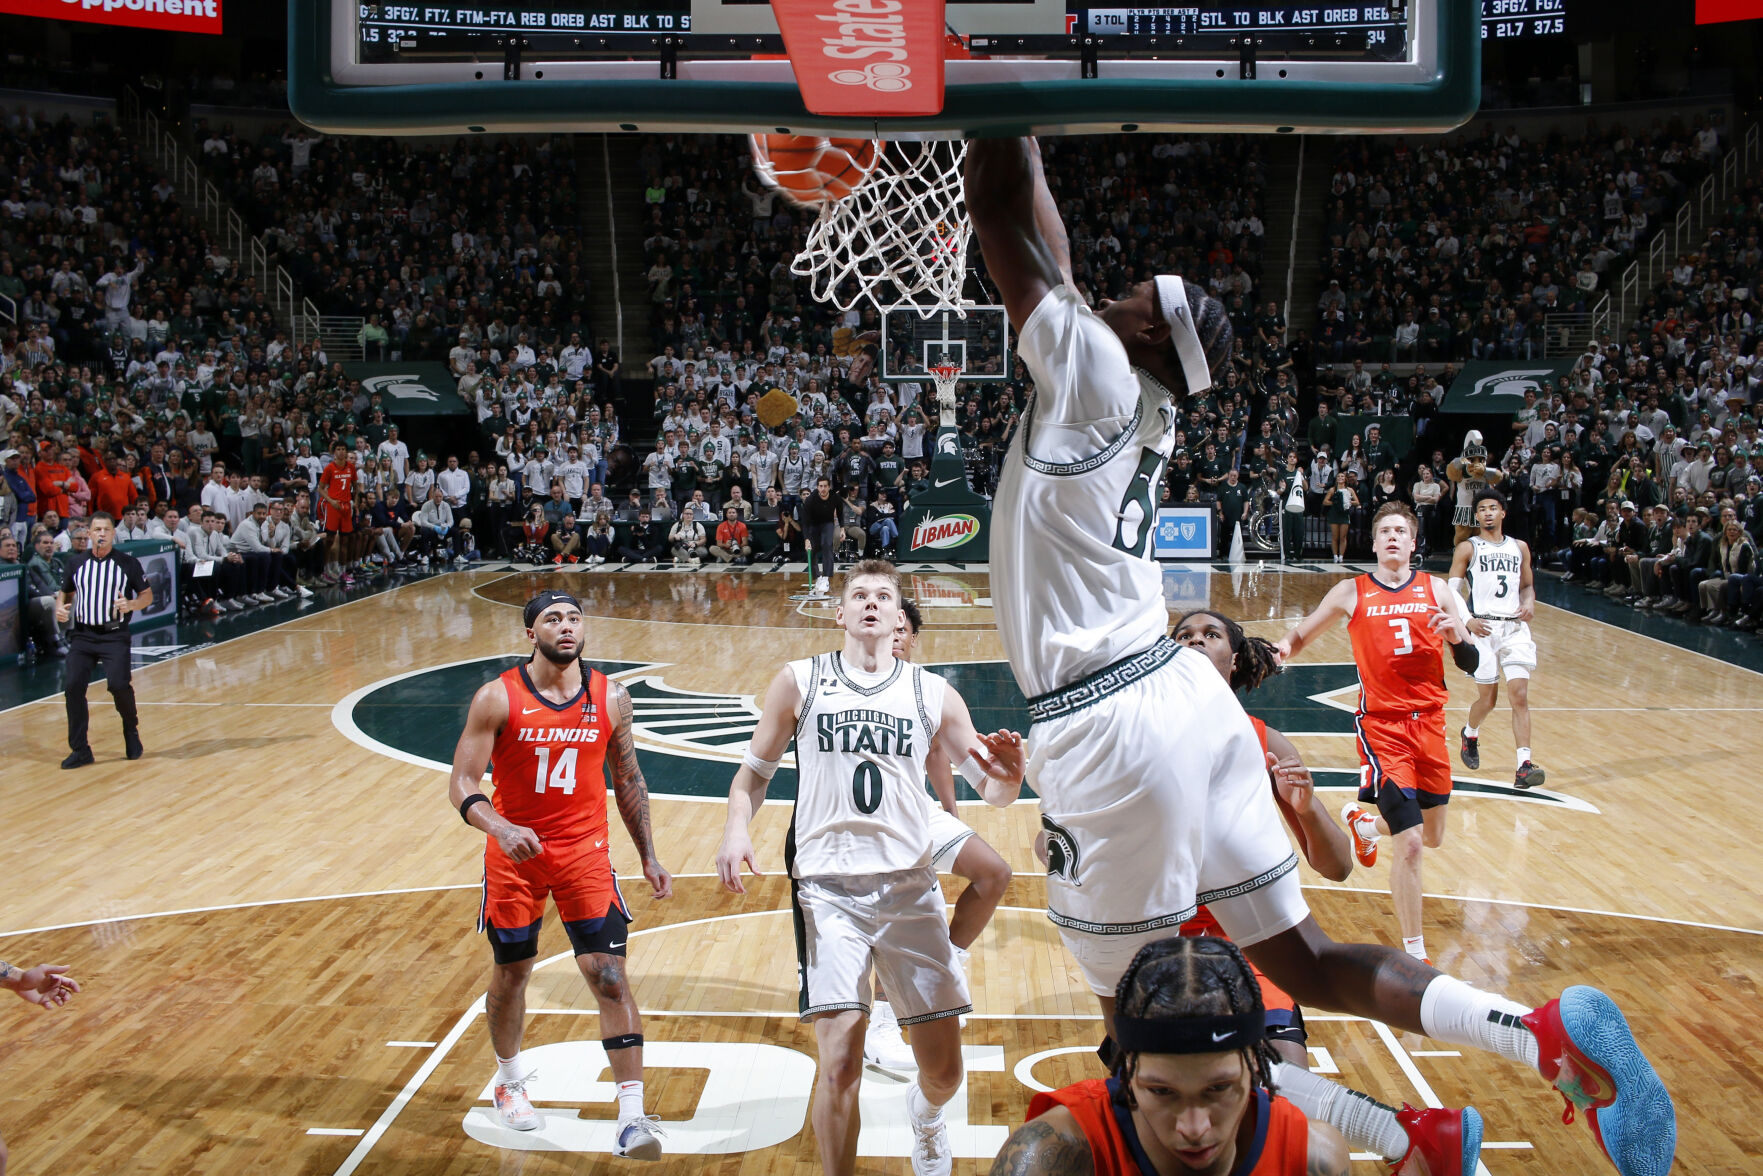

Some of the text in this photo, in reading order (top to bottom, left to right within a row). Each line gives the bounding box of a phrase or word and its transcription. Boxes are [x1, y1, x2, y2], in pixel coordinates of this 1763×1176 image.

[384, 6, 419, 21] 3FG%
[425, 8, 450, 22] FT%
[456, 10, 516, 25] FTM-FTA
[521, 12, 546, 26] REB
[551, 13, 585, 27] OREB
[590, 14, 616, 28] AST
[624, 15, 649, 28] BLK
[656, 15, 673, 28] TO
[681, 15, 691, 28] S
[1094, 15, 1124, 26] 3 TOL
[1201, 7, 1390, 26] STL TO BLK AST OREB REB
[1367, 30, 1386, 43] 34
[1496, 22, 1524, 37] 21.7
[1534, 19, 1564, 34] 37.5
[340, 479, 347, 490] 7
[911, 519, 974, 550] LIBMAN
[1479, 554, 1520, 574] STATE
[1494, 575, 1508, 598] 3
[1366, 602, 1429, 617] ILLINOIS
[1388, 618, 1414, 656] 3
[836, 709, 896, 728] MICHIGAN
[517, 727, 600, 743] ILLINOIS
[817, 712, 913, 758] STATE
[534, 747, 579, 795] 14
[853, 760, 883, 815] 0
